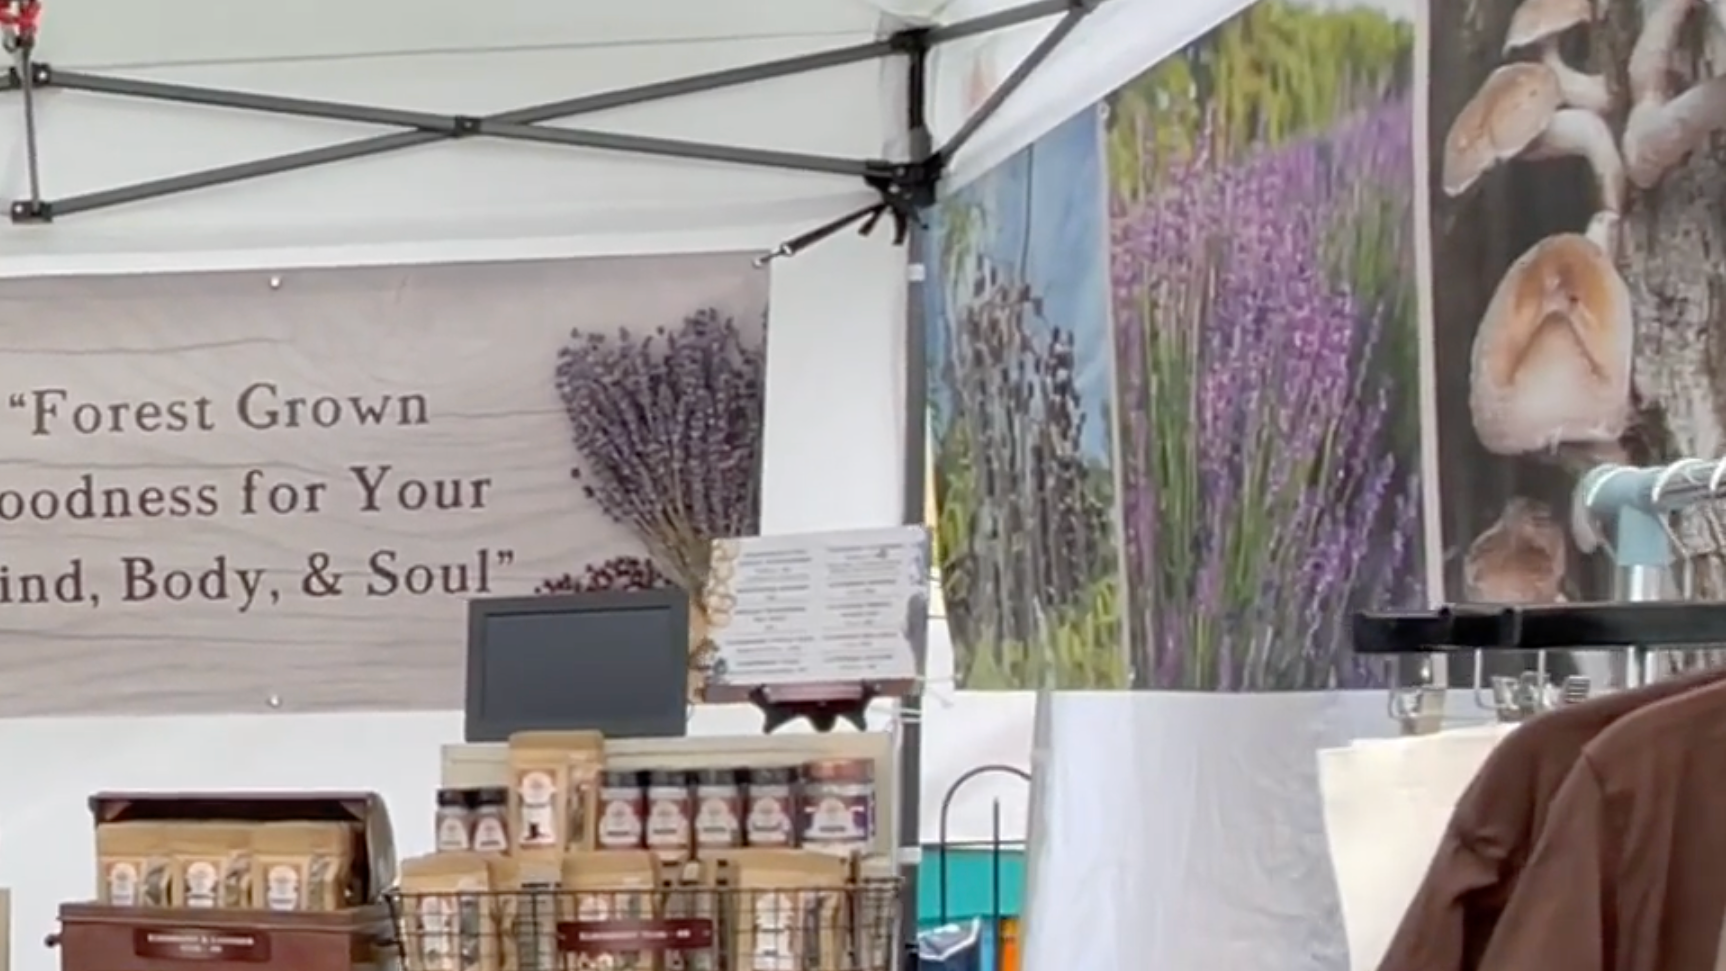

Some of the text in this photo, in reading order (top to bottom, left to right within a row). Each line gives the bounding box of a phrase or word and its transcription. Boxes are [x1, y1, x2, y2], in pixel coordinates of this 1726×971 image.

[236, 382, 430, 429] Grown
[240, 469, 328, 514] for
[349, 464, 493, 512] Your
[120, 555, 280, 612] Body,
[301, 551, 343, 598] &
